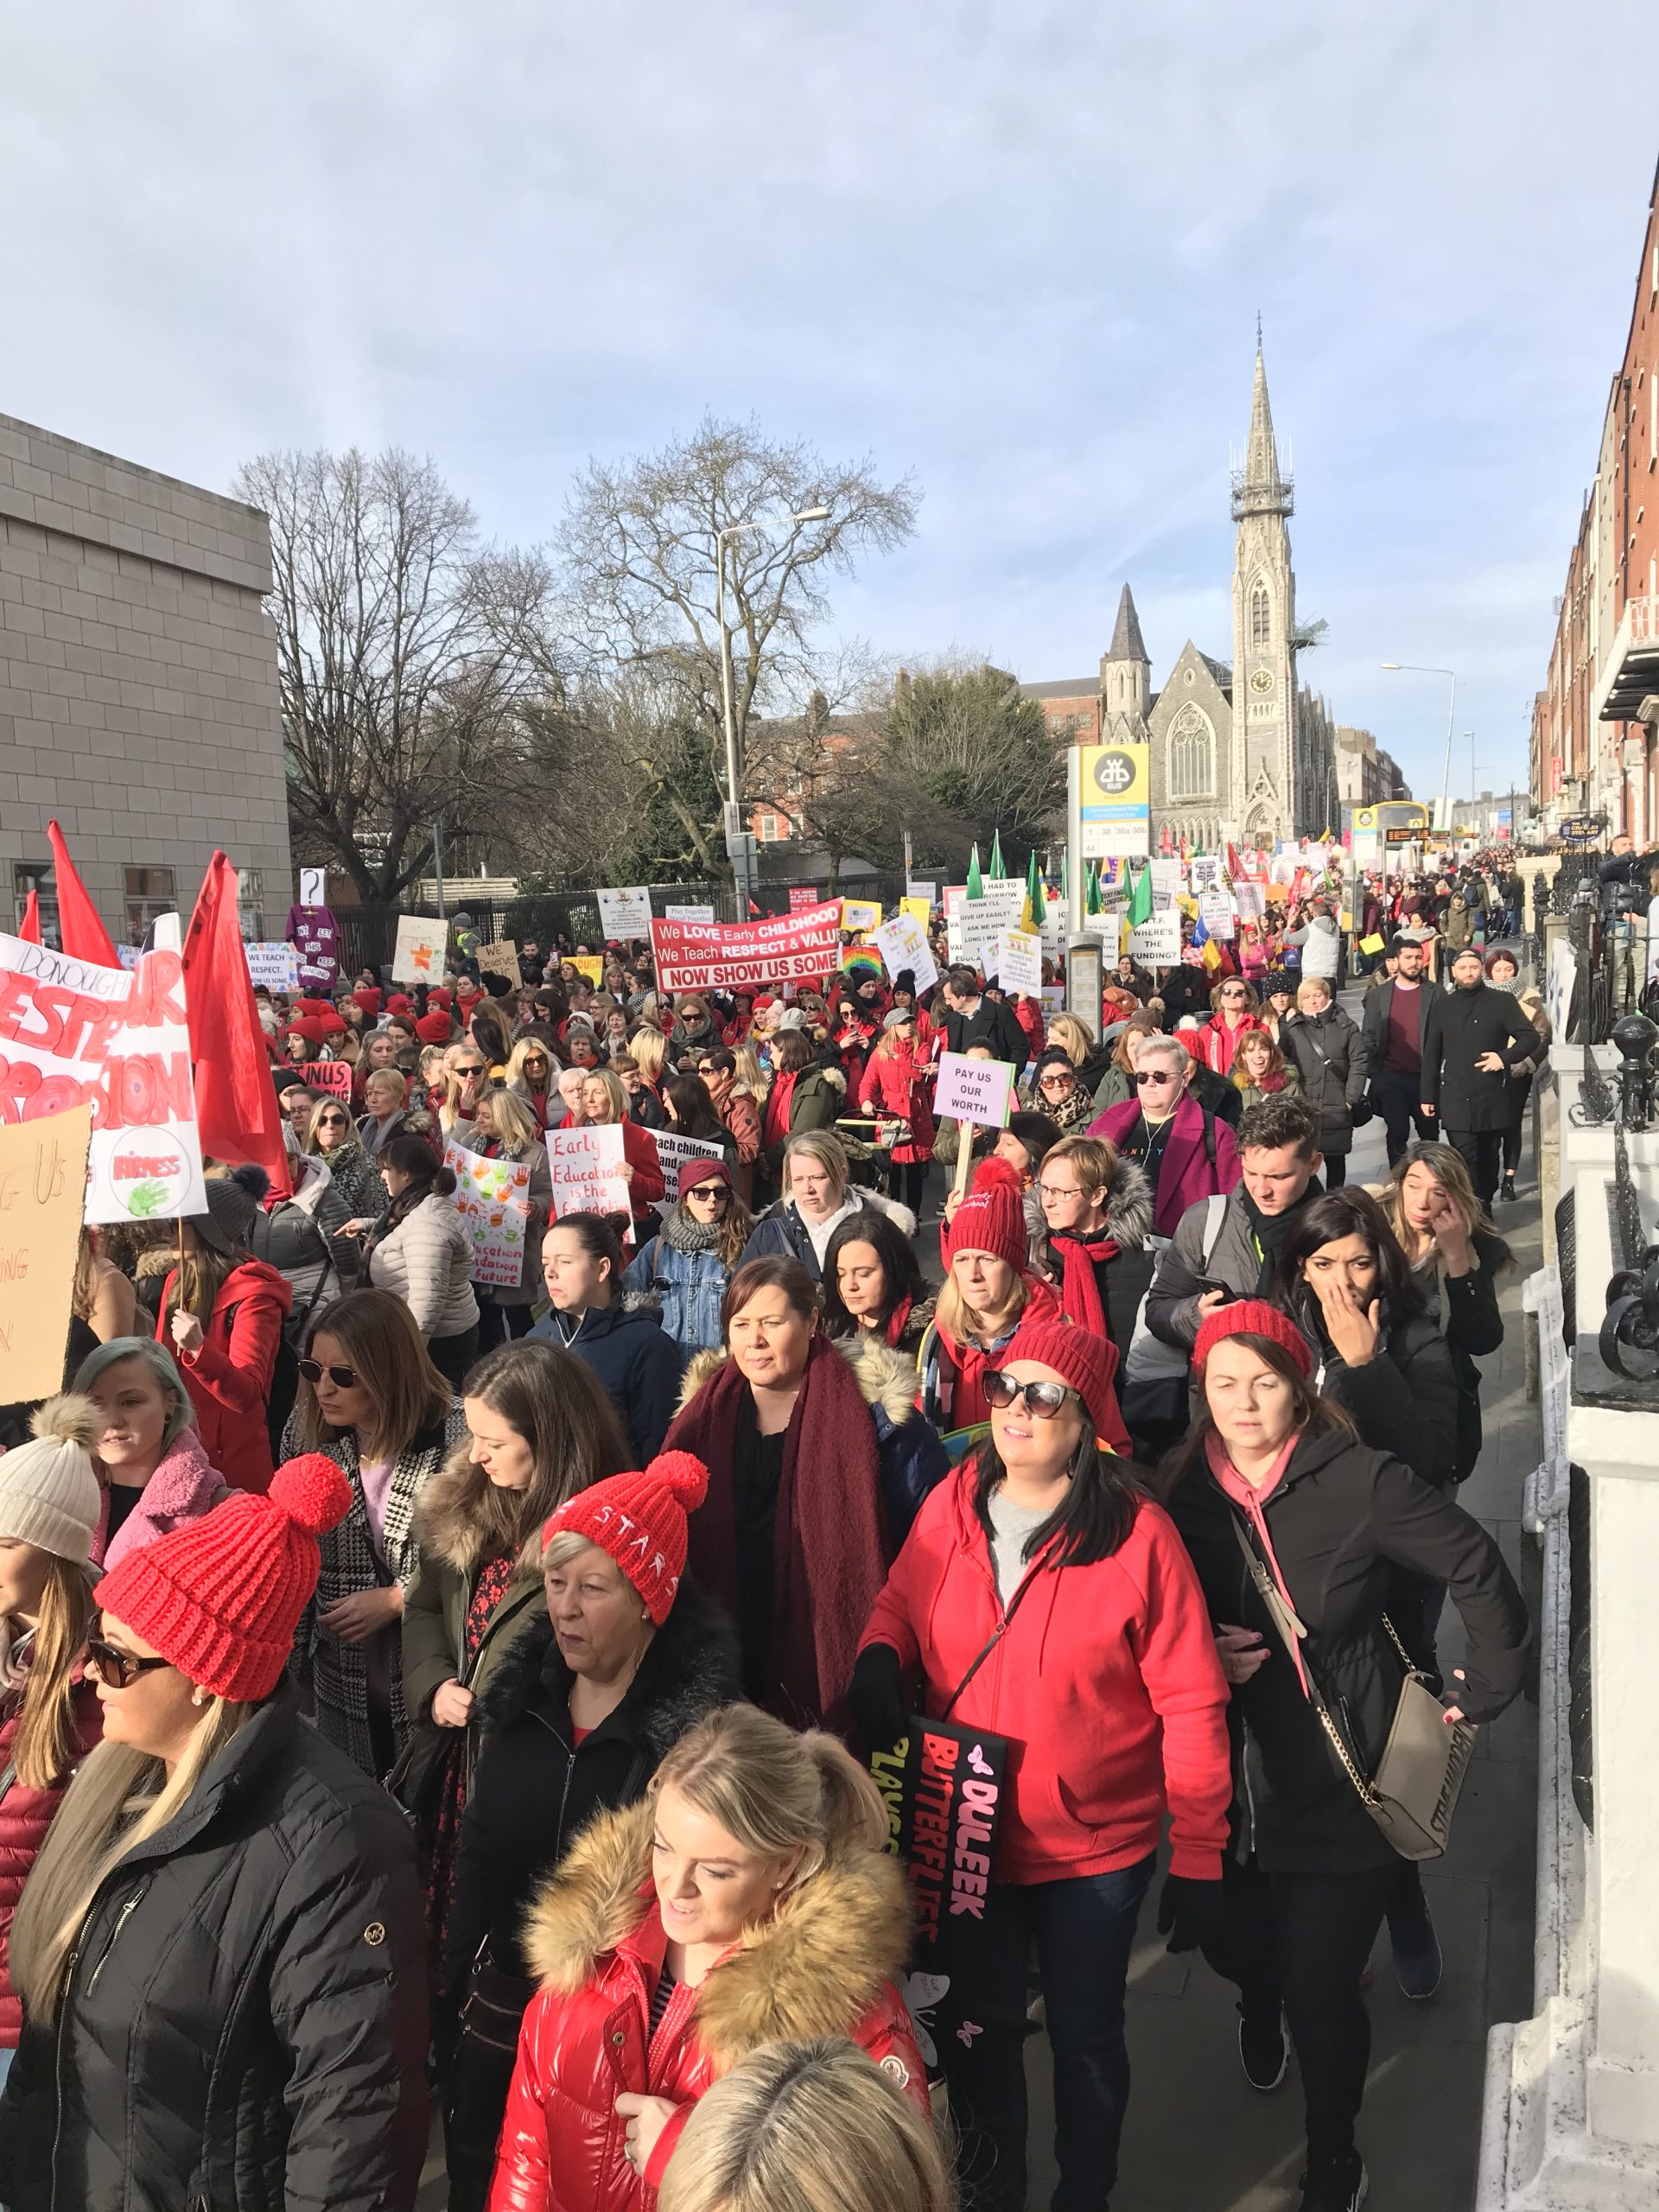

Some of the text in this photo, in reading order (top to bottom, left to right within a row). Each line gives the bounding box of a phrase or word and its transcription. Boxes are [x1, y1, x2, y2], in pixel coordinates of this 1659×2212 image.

[1132, 826, 1147, 834] 38b
[659, 925, 680, 940] We
[683, 925, 721, 941] LOVE
[724, 928, 755, 942] Early
[758, 906, 839, 938] CHILDHOOD
[486, 945, 502, 956] WE
[657, 947, 679, 962] We
[681, 945, 718, 960] Teach
[721, 940, 786, 958] RESPECT
[790, 937, 799, 950] &
[319, 957, 334, 965] KEEP
[670, 968, 709, 987] NOW
[713, 963, 763, 984] SHOW
[767, 960, 790, 978] US
[793, 950, 837, 974] SOME
[955, 1068, 991, 1083] PAY US
[960, 1085, 982, 1097] OUR
[951, 1098, 988, 1114] WORTH
[554, 1134, 600, 1161] Early
[657, 1138, 718, 1158] ach children
[660, 1156, 677, 1170] and
[570, 1183, 608, 1198] is the
[473, 1256, 518, 1272] ndation
[950, 1779, 998, 1920] DULEEK
